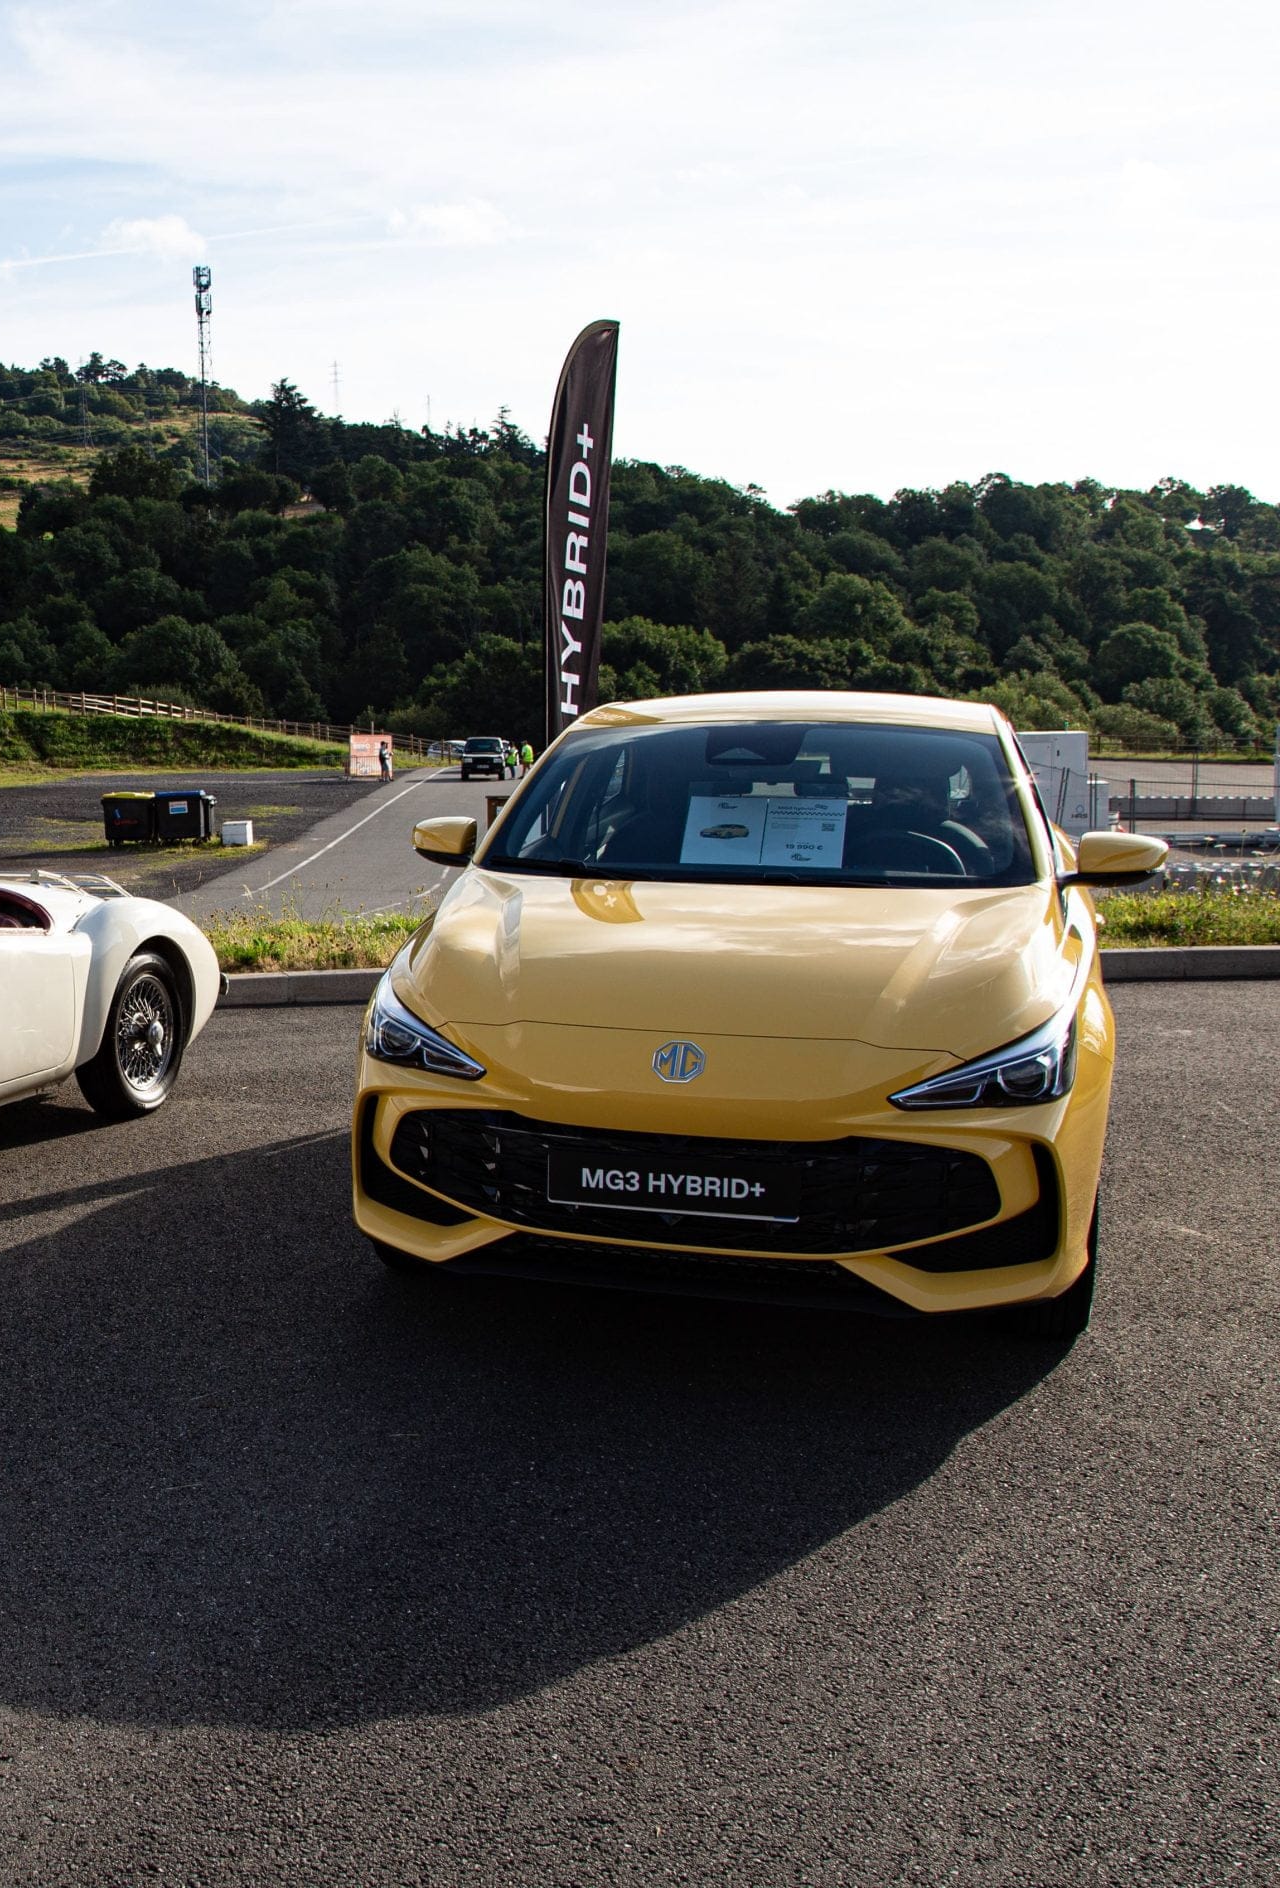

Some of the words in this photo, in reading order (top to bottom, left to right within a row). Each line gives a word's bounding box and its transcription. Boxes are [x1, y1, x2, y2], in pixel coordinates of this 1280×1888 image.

[561, 423, 594, 716] HYBRID+
[658, 1045, 701, 1078] MG
[581, 1167, 640, 1192] MG3
[648, 1172, 766, 1199] HYBRID+
